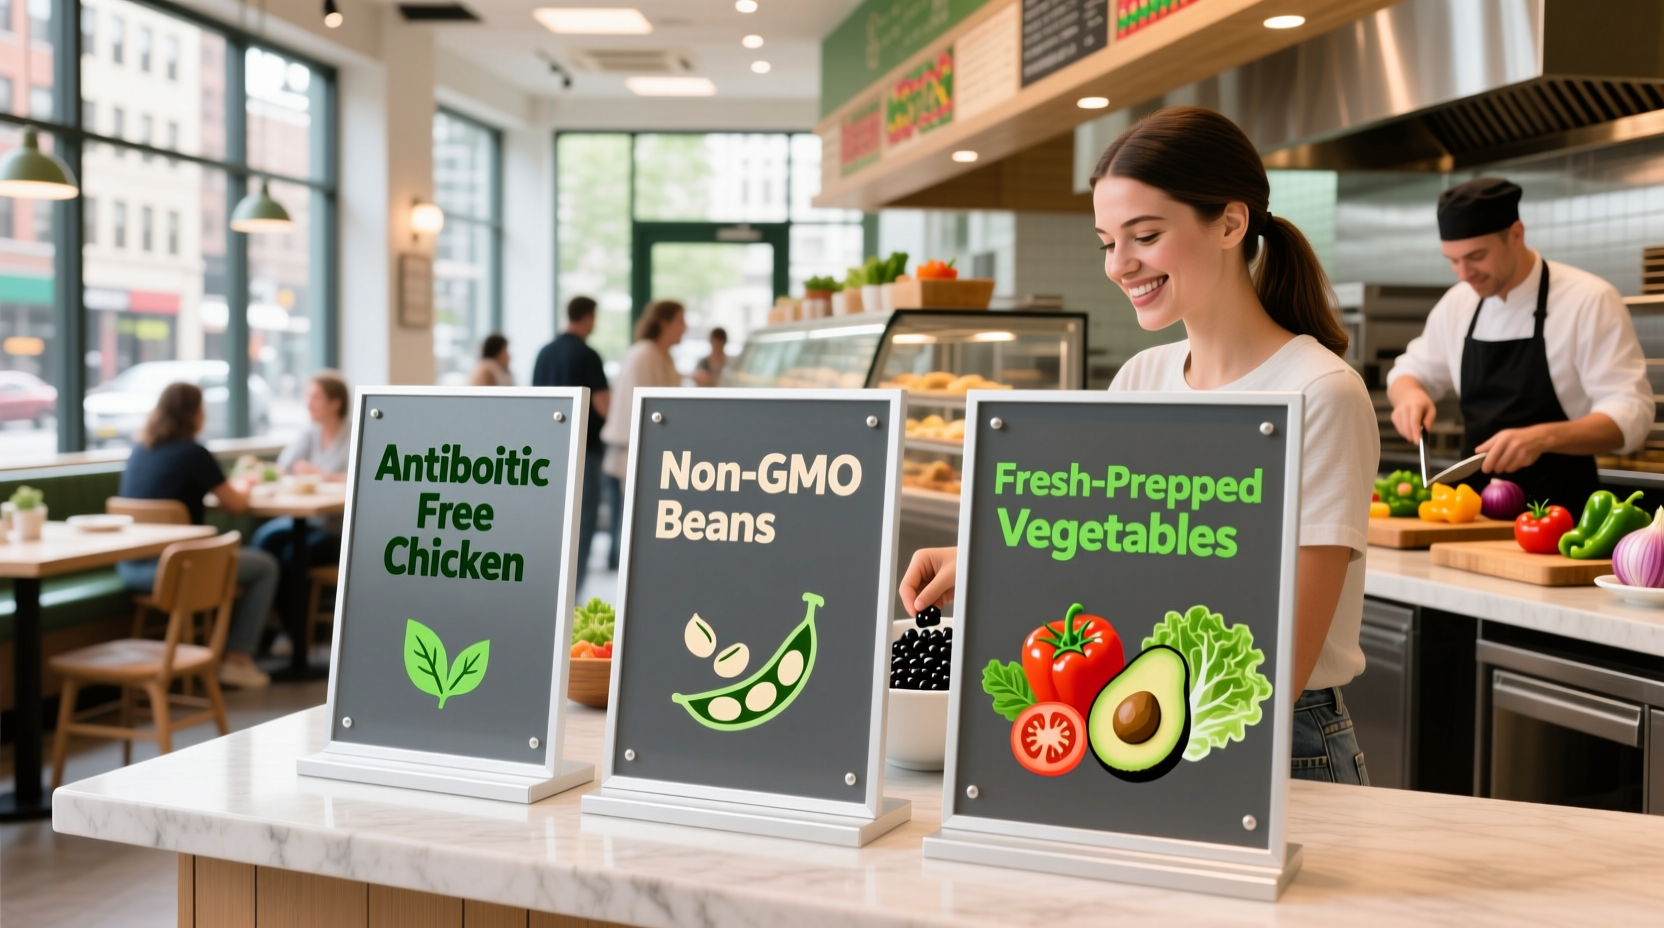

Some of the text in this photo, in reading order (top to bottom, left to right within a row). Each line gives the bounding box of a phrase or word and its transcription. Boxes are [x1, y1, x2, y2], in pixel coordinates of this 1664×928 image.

[374, 443, 550, 487] Antiboitic
[660, 450, 862, 496] Non-GMO
[995, 462, 1263, 510] Fresh-Prepped
[417, 492, 494, 531] Free
[655, 500, 776, 544] Beans
[997, 508, 1238, 561] Vegetables
[384, 536, 524, 582] Chicken
